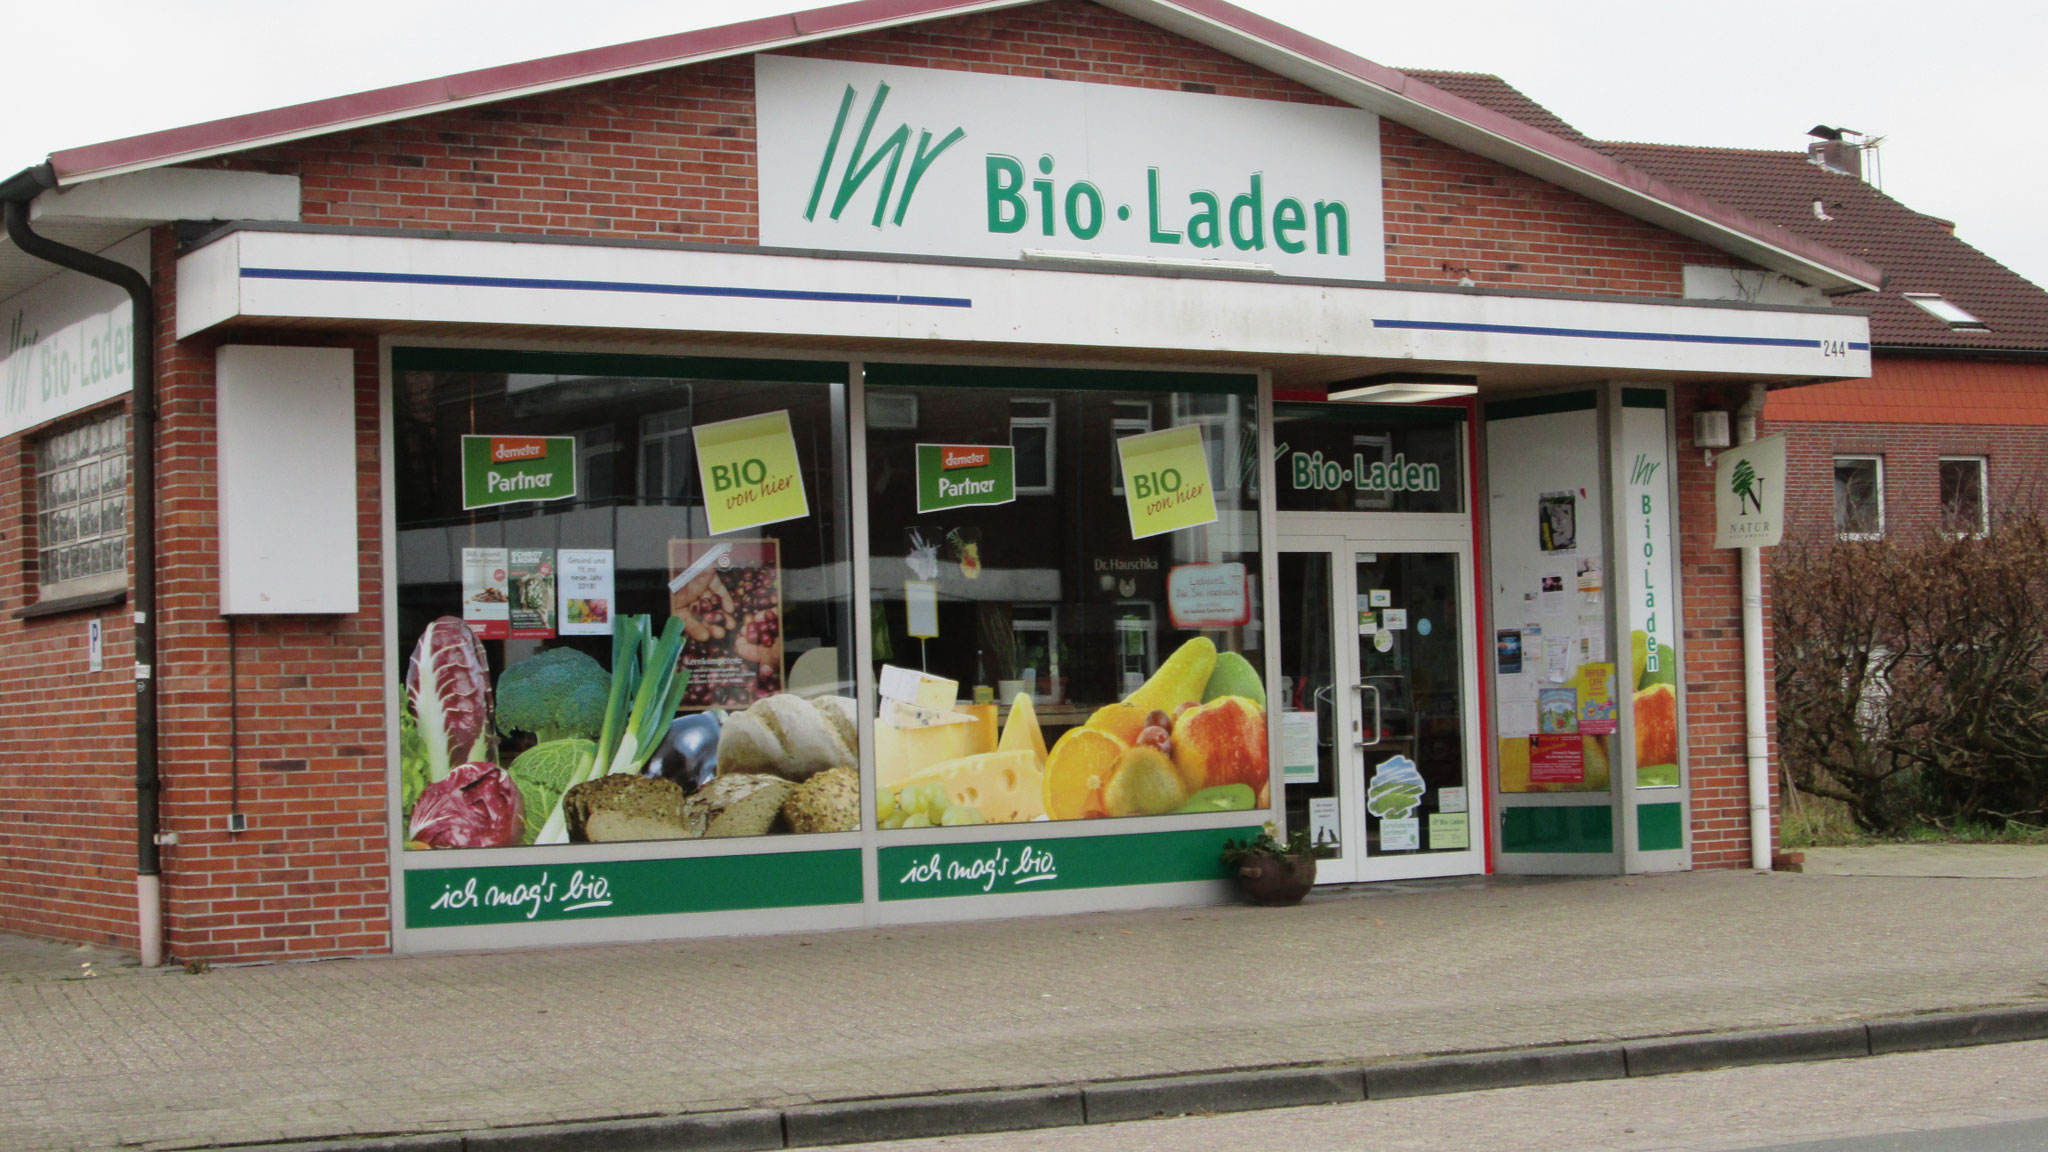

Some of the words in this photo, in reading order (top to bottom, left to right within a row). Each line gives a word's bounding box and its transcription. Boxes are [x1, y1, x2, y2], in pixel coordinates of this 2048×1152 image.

[803, 80, 967, 230] Ihr
[1823, 340, 1845, 357] 244
[495, 443, 541, 459] demeter
[945, 452, 984, 466] demeter
[487, 471, 552, 493] Partner
[711, 458, 767, 492] BIO
[1133, 468, 1182, 499] BIO
[1630, 453, 1661, 486] Ihr
[726, 489, 757, 510] von
[761, 474, 793, 497] hier
[938, 477, 995, 498] Partner
[1146, 496, 1173, 516] von
[1175, 483, 1204, 504] hier
[1730, 522, 1770, 533] NATUR
[1110, 558, 1158, 570] Hauschka
[900, 853, 941, 883] ich
[947, 847, 1009, 891] mag's
[430, 877, 478, 909] ich
[485, 871, 557, 919] mag's
